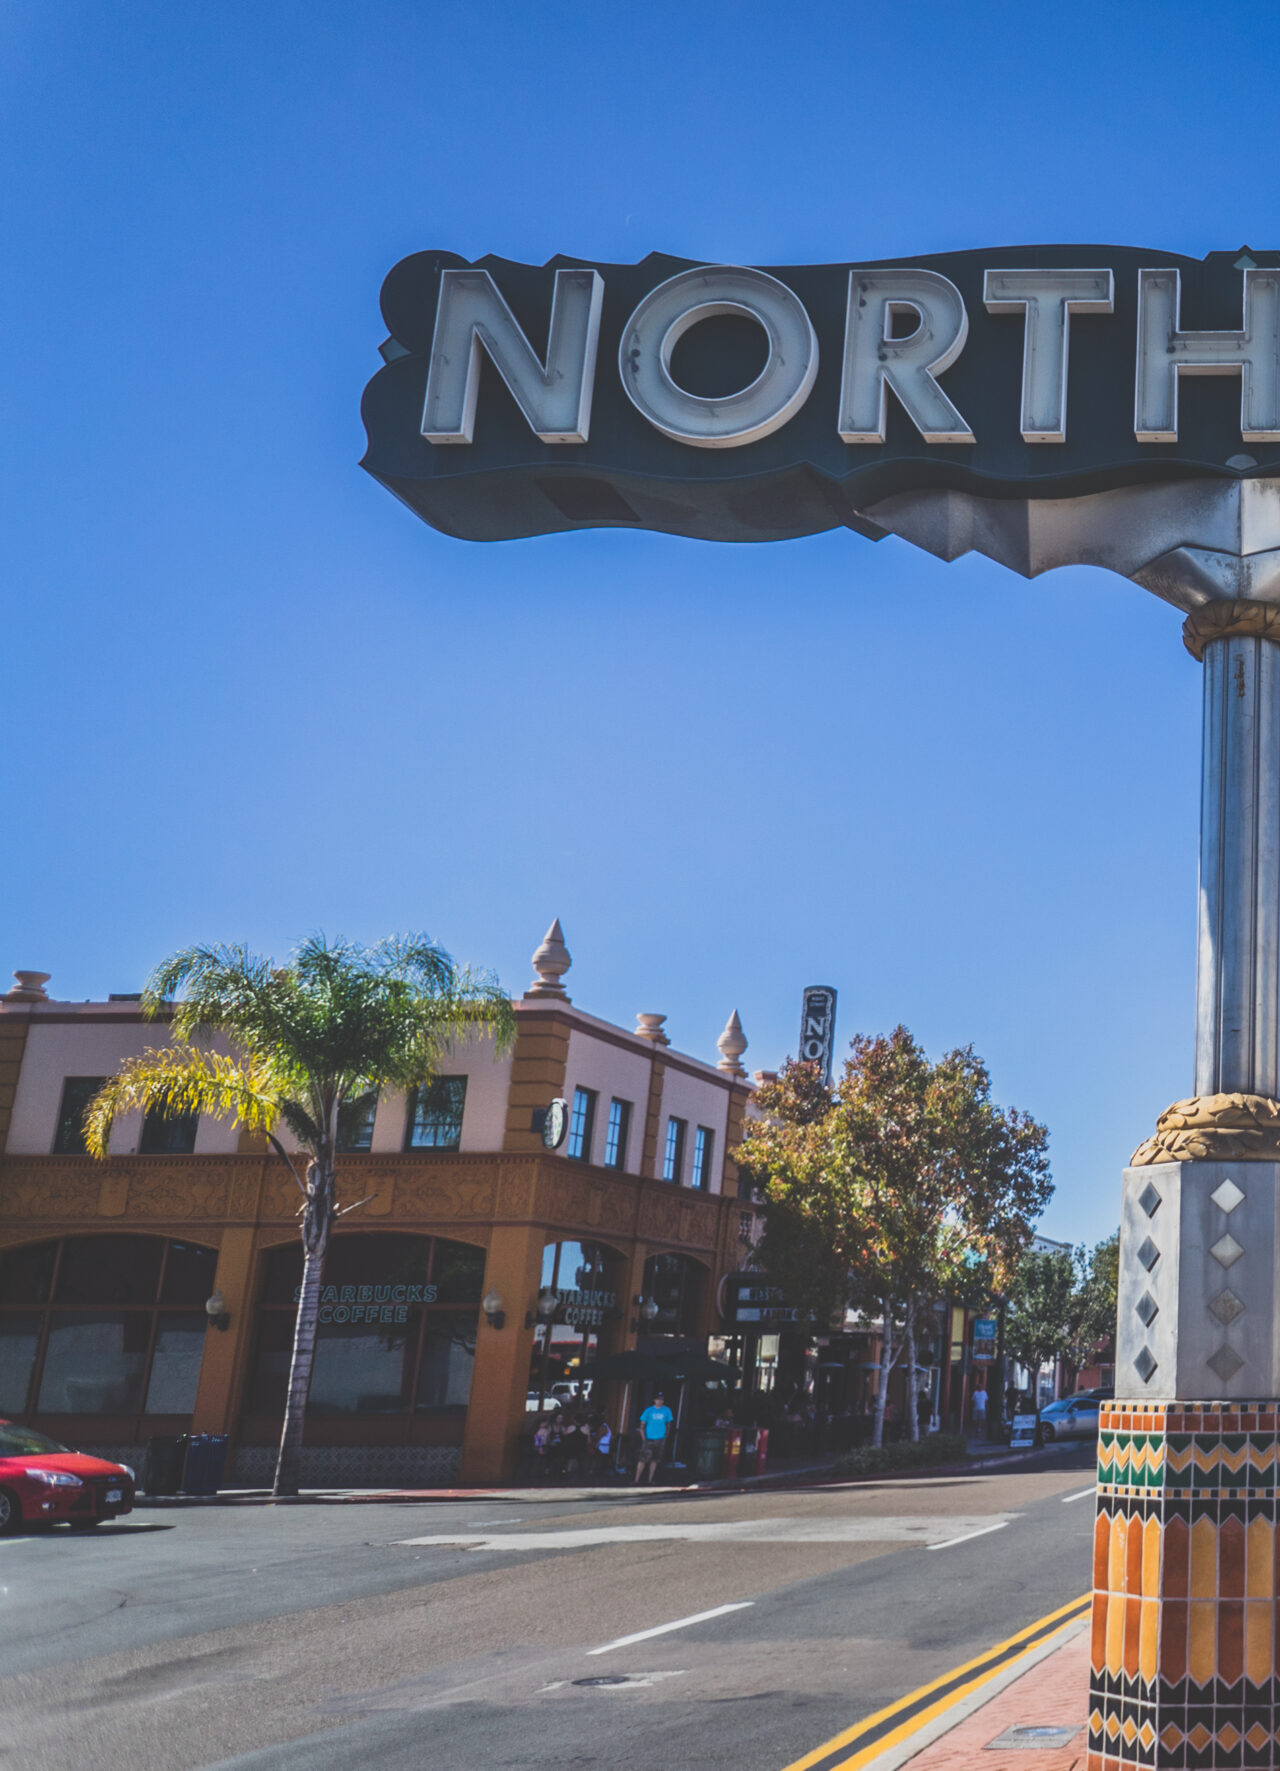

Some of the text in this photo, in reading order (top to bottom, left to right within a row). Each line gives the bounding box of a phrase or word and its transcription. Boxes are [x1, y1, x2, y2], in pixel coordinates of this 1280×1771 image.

[294, 1285, 437, 1302] SARBUCKS
[318, 1305, 409, 1323] COFFEE
[565, 1307, 604, 1326] COFFEE
